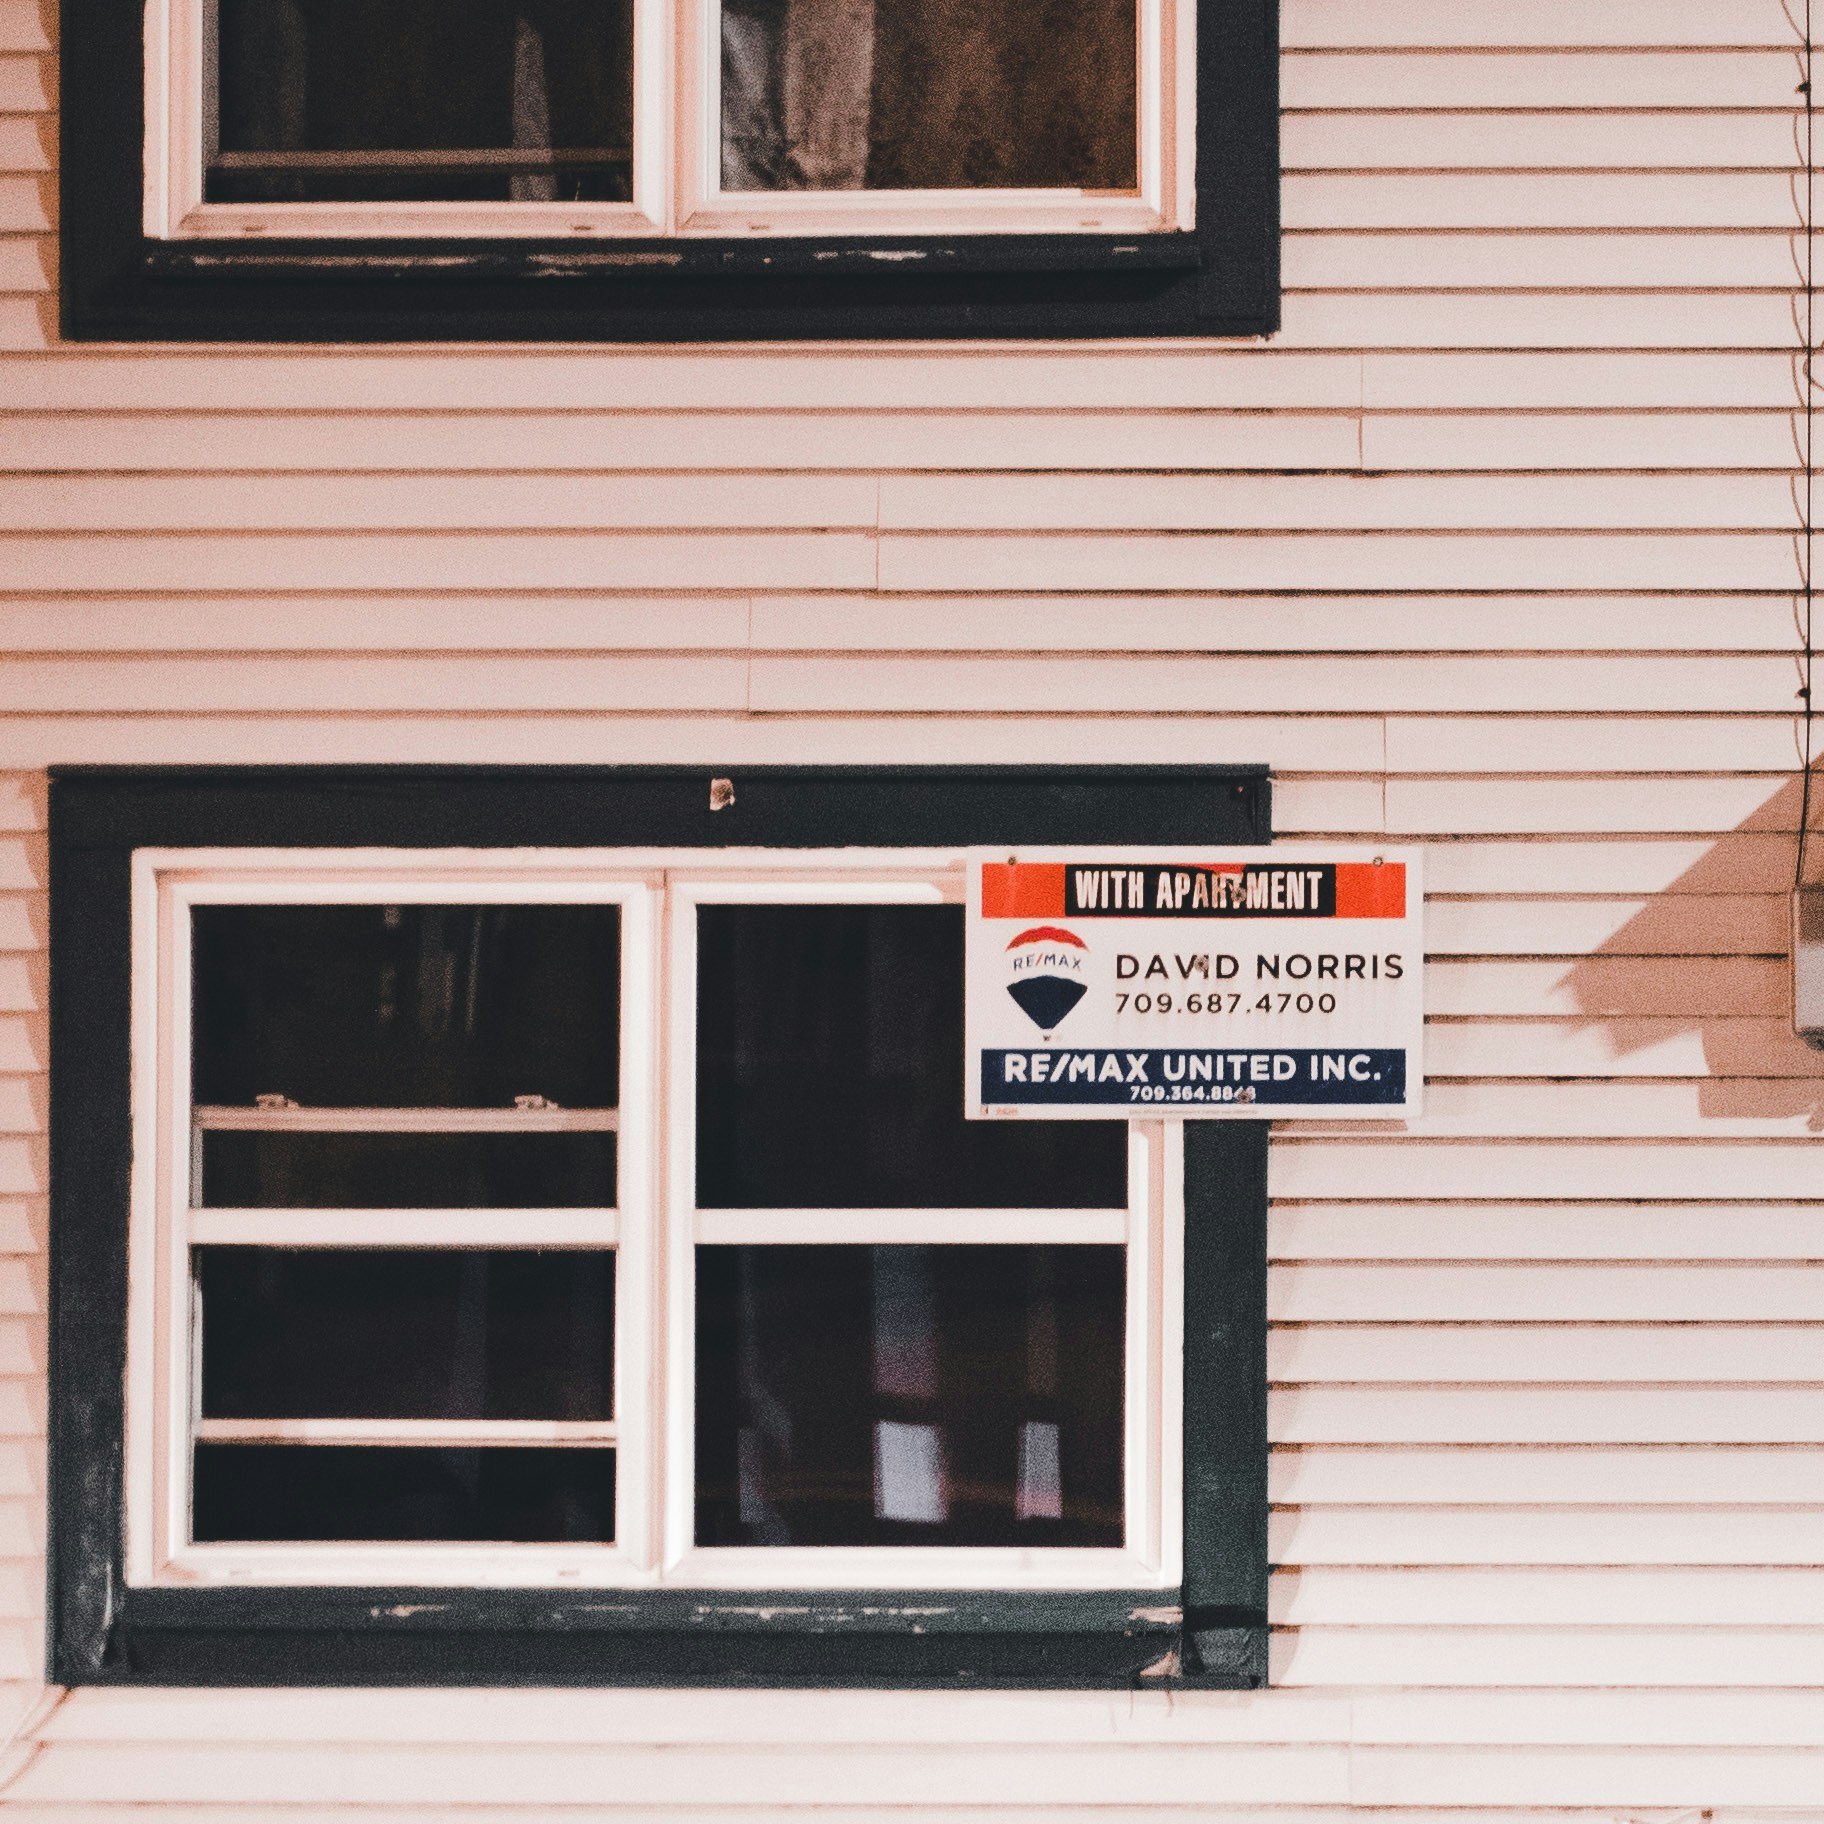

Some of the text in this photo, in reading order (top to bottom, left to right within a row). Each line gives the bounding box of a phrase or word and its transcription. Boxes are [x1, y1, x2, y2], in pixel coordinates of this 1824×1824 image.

[1075, 870, 1323, 911] WITH APARTMENT
[1013, 952, 1082, 972] RE/MAX
[1116, 954, 1405, 980] DAVID NORRIS
[1116, 994, 1338, 1015] 709.687.4700
[1005, 1054, 1383, 1083] RE/MAX UNITED INC.
